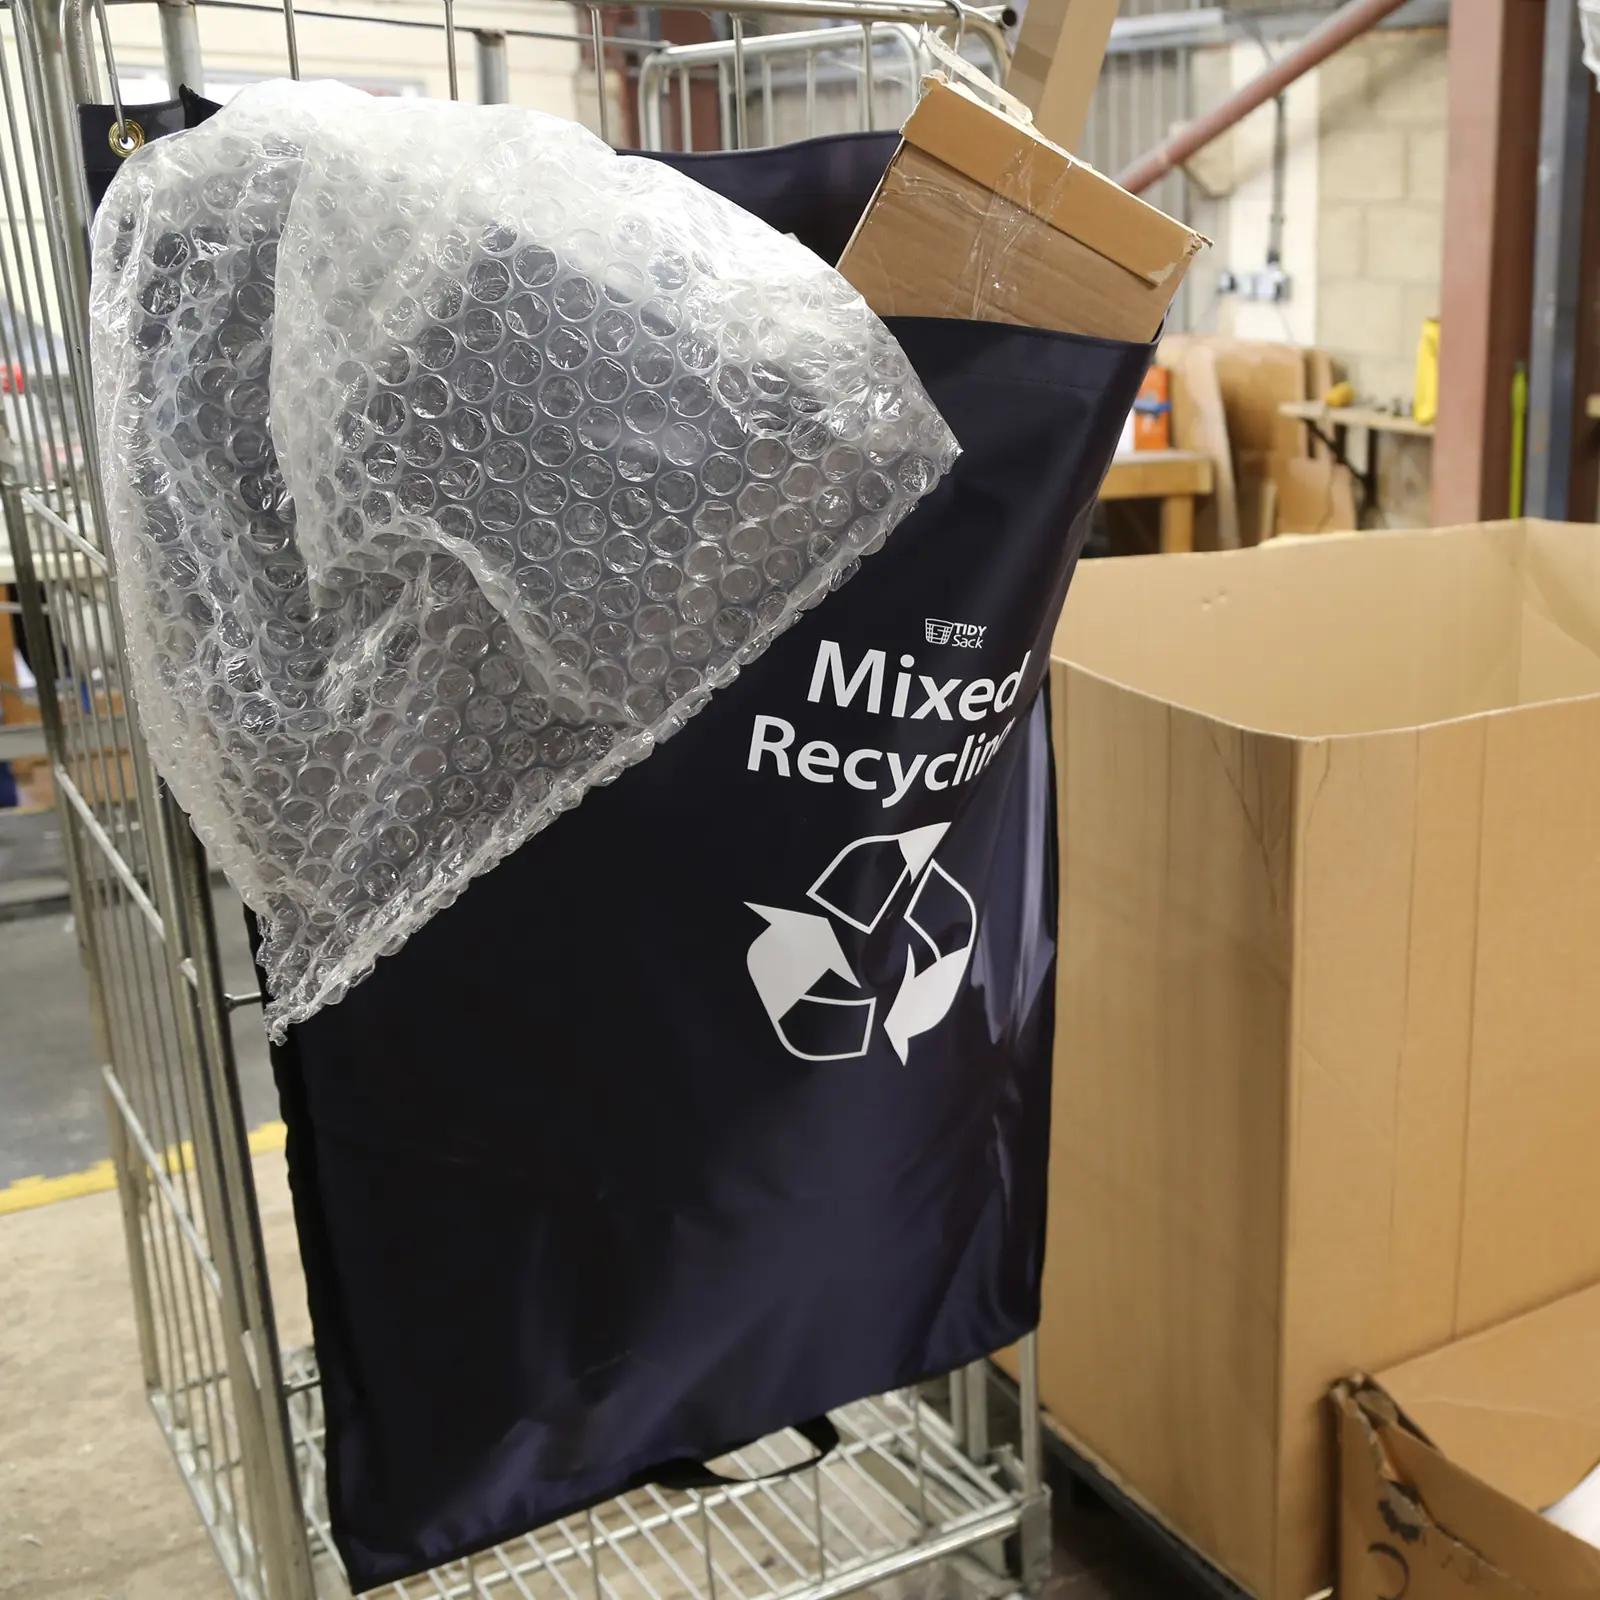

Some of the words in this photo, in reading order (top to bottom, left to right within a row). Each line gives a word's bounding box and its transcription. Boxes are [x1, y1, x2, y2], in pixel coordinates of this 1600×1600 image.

[954, 622, 987, 637] TIDY
[952, 634, 984, 649] Sack
[806, 639, 1032, 722] Mixed
